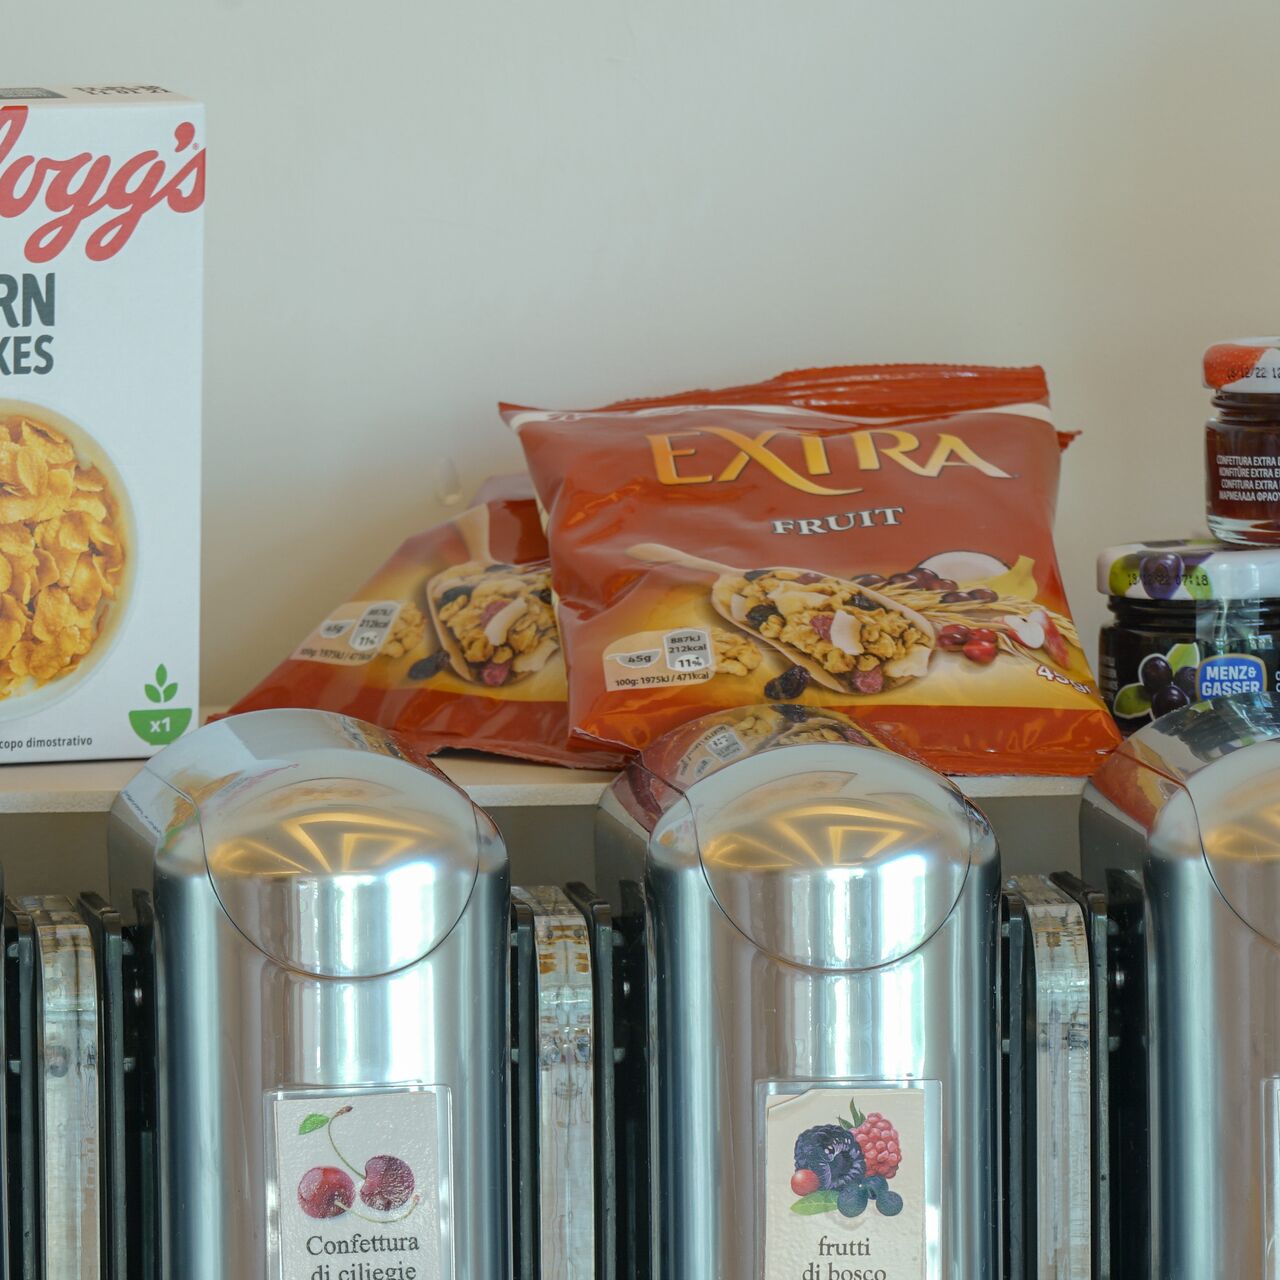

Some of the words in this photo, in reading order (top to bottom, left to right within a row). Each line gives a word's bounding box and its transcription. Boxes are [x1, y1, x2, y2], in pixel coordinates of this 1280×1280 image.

[645, 426, 1013, 496] EXTRA
[1253, 456, 1277, 467] EXTRA
[1251, 467, 1274, 478] EXTRA
[1254, 479, 1278, 490] EXTRA
[772, 506, 904, 536] FRUIT
[668, 643, 707, 654] 212kcal
[627, 655, 652, 663] 45g
[1206, 665, 1256, 680] MENZ&
[1201, 680, 1260, 697] GASSER
[149, 716, 172, 732] x1
[26, 736, 93, 750] dimostrativo
[306, 1233, 420, 1256] Confettura
[818, 1236, 871, 1256] frutti
